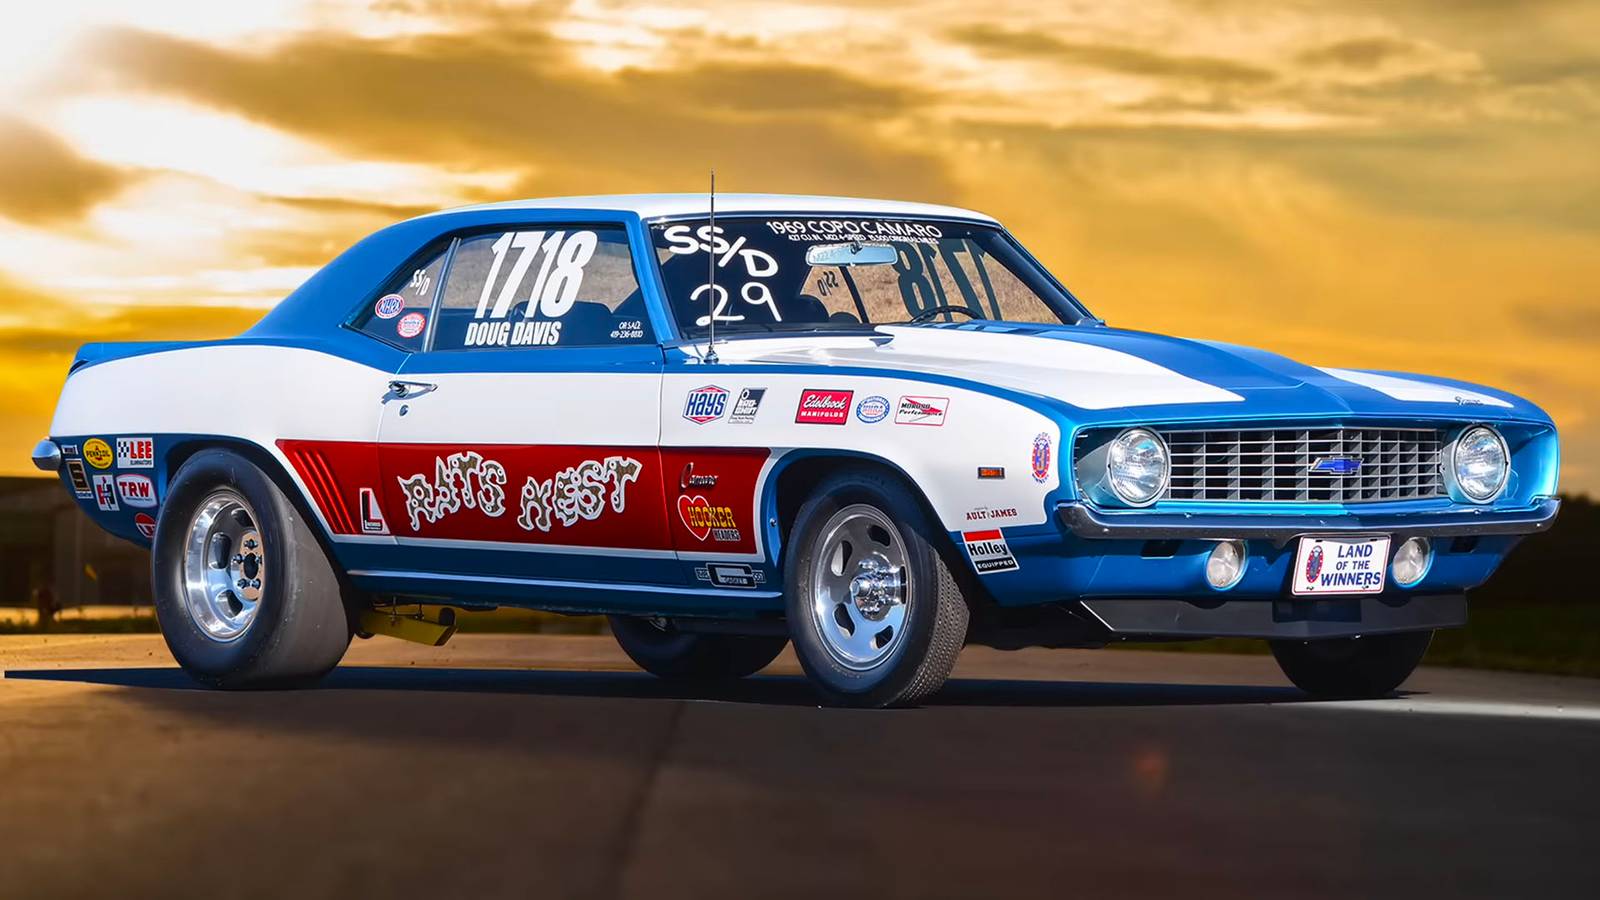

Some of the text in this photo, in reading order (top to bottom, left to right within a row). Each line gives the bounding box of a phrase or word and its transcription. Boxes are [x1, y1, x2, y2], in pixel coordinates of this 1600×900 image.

[766, 221, 943, 239] 1969 COPO CAMARO
[664, 225, 779, 278] SS/D
[410, 269, 431, 296] SS/D
[475, 231, 598, 319] 1718
[690, 282, 782, 326] 29
[464, 322, 562, 346] DOUG DAVIS
[803, 394, 846, 410] Edelbrock
[130, 440, 152, 459] LEE
[119, 481, 150, 498] TRW
[397, 451, 507, 532] RATS
[688, 506, 737, 528] HOOKER
[966, 511, 987, 521] AULT
[990, 508, 1018, 519] JAMES
[967, 541, 1009, 556] Holley
[1337, 544, 1373, 558] LAND
[977, 559, 1014, 569] EQUIPPED
[1335, 560, 1370, 570] OF THE
[1321, 571, 1381, 586] WINNERS
